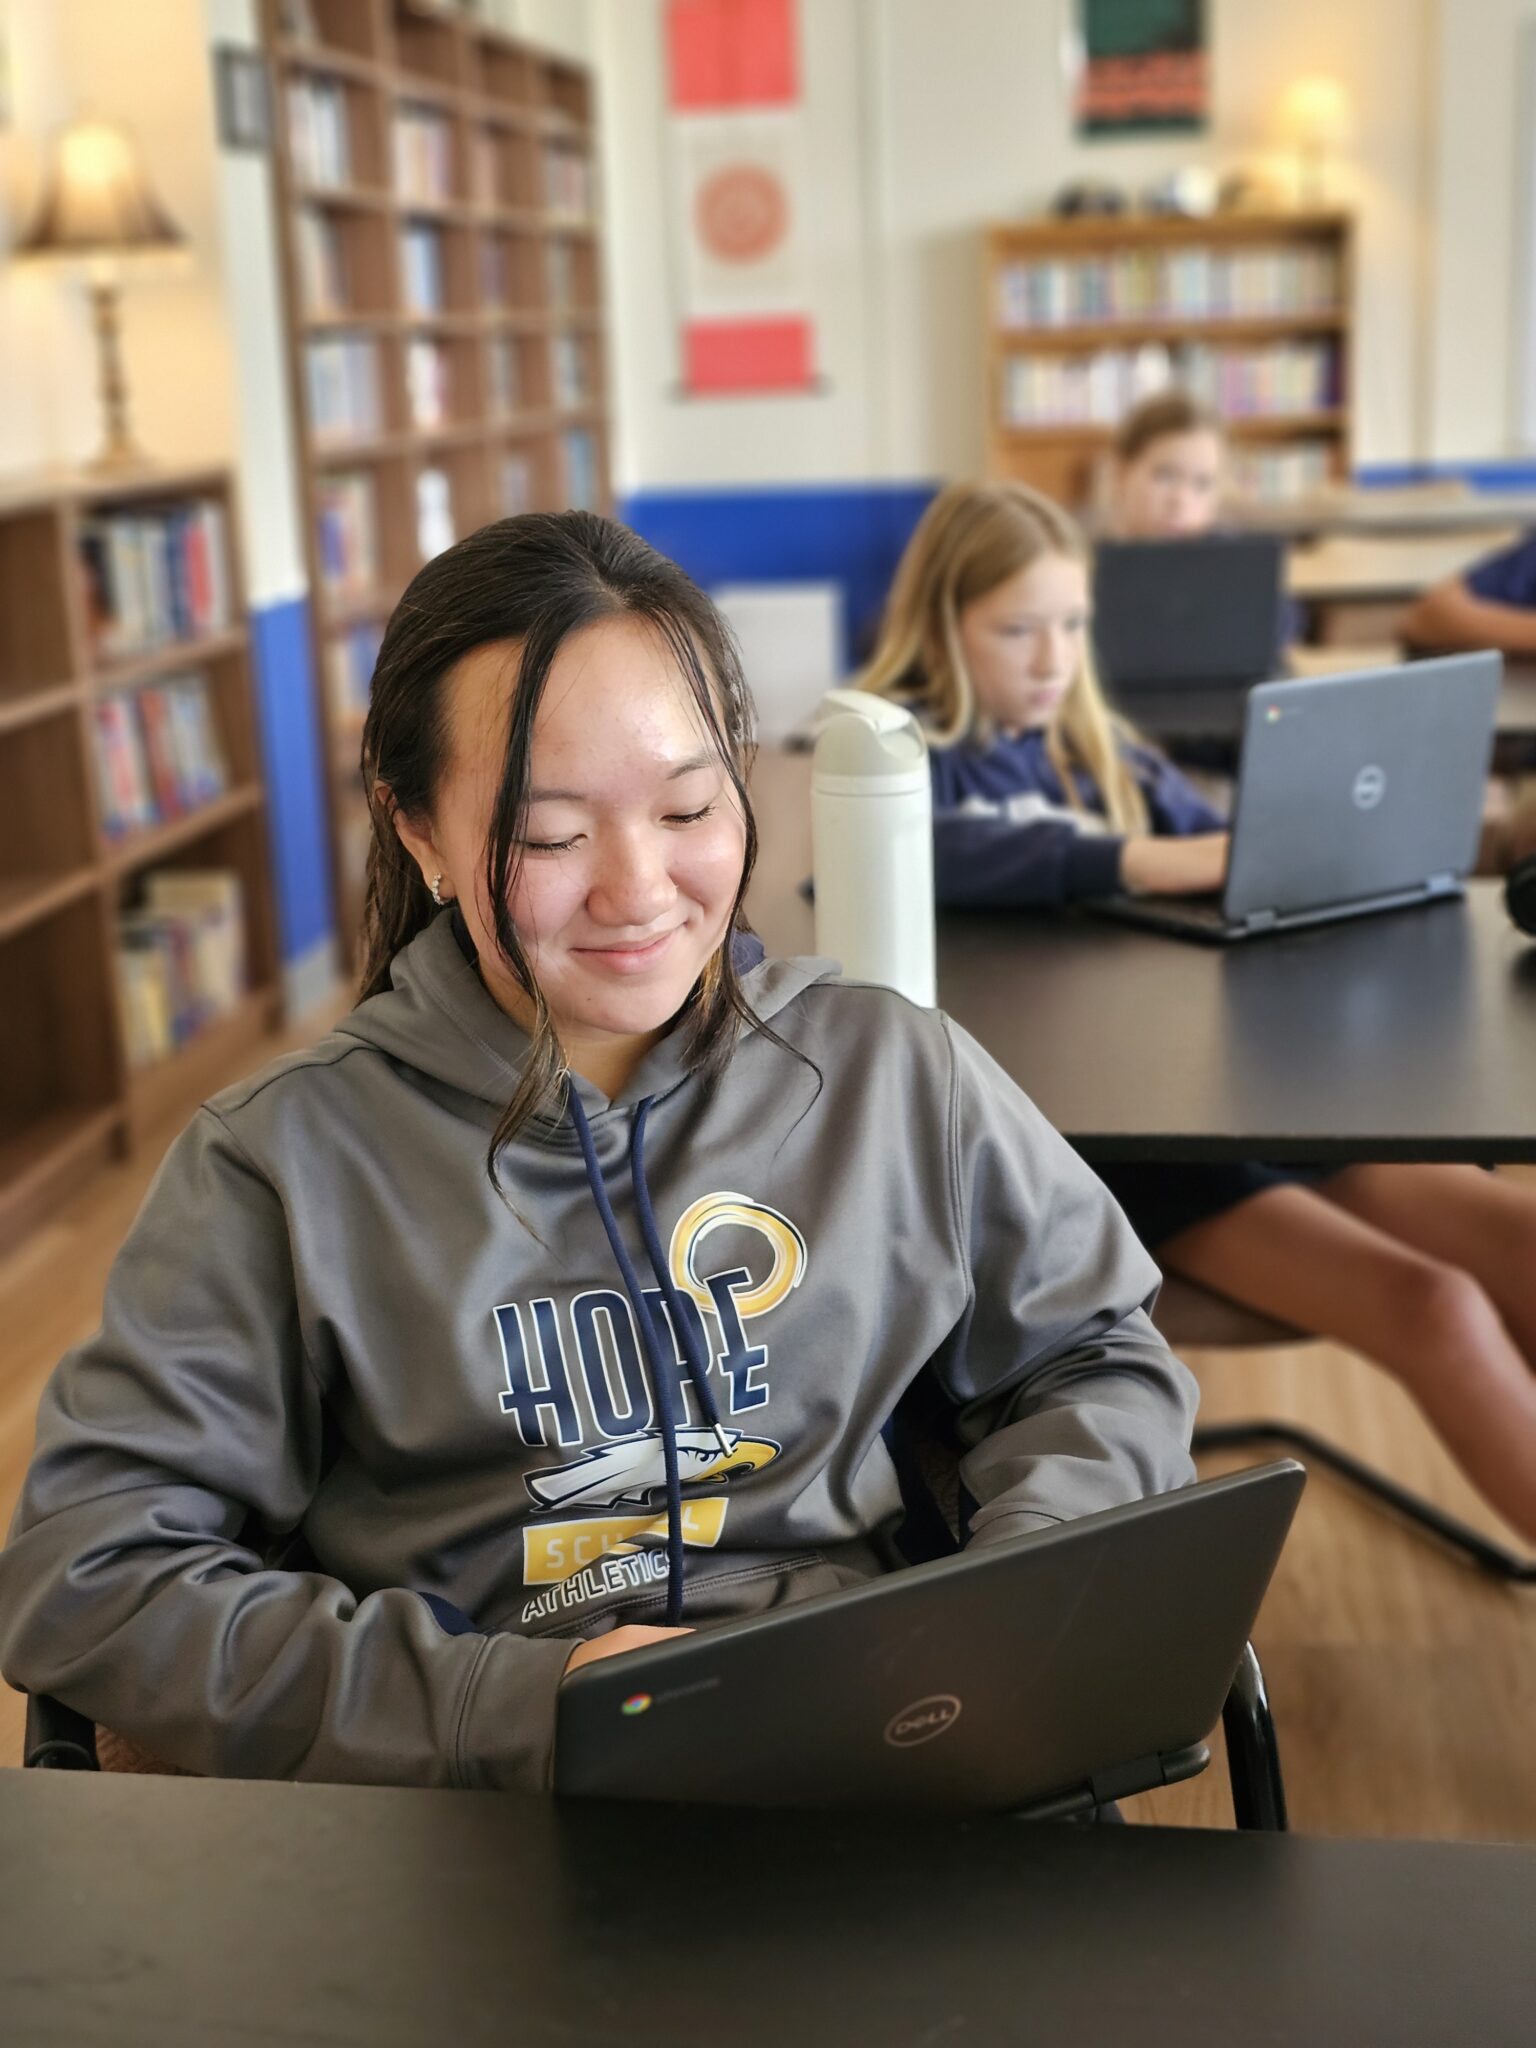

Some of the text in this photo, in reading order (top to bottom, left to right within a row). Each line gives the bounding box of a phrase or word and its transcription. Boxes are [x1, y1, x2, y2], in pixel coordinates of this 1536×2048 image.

[493, 1266, 769, 1447] HOPE
[546, 1506, 699, 1568] SCL
[894, 1707, 953, 1736] DELL
